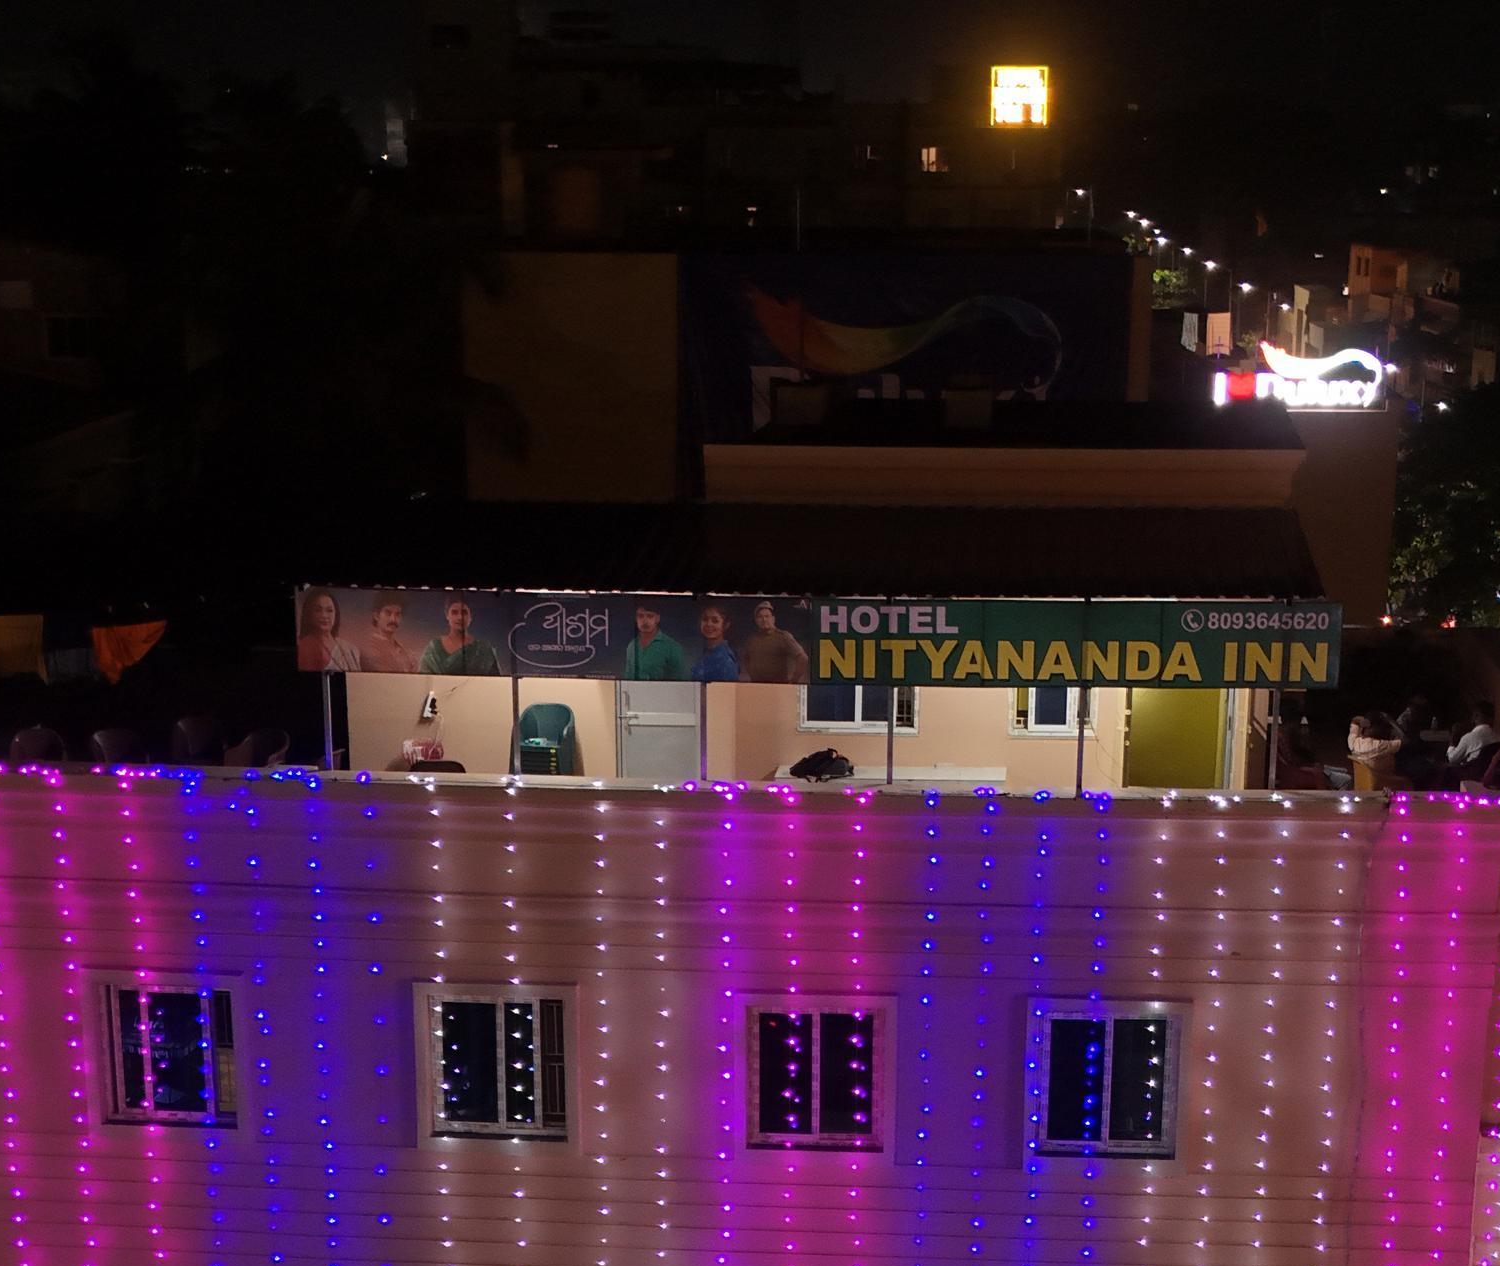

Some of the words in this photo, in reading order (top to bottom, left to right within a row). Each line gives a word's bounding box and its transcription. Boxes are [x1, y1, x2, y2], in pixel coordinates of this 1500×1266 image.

[820, 606, 959, 634] HOTEL
[1207, 612, 1330, 631] 8093645620
[819, 639, 1202, 681] NITYANANDA
[1222, 642, 1329, 682] INN
